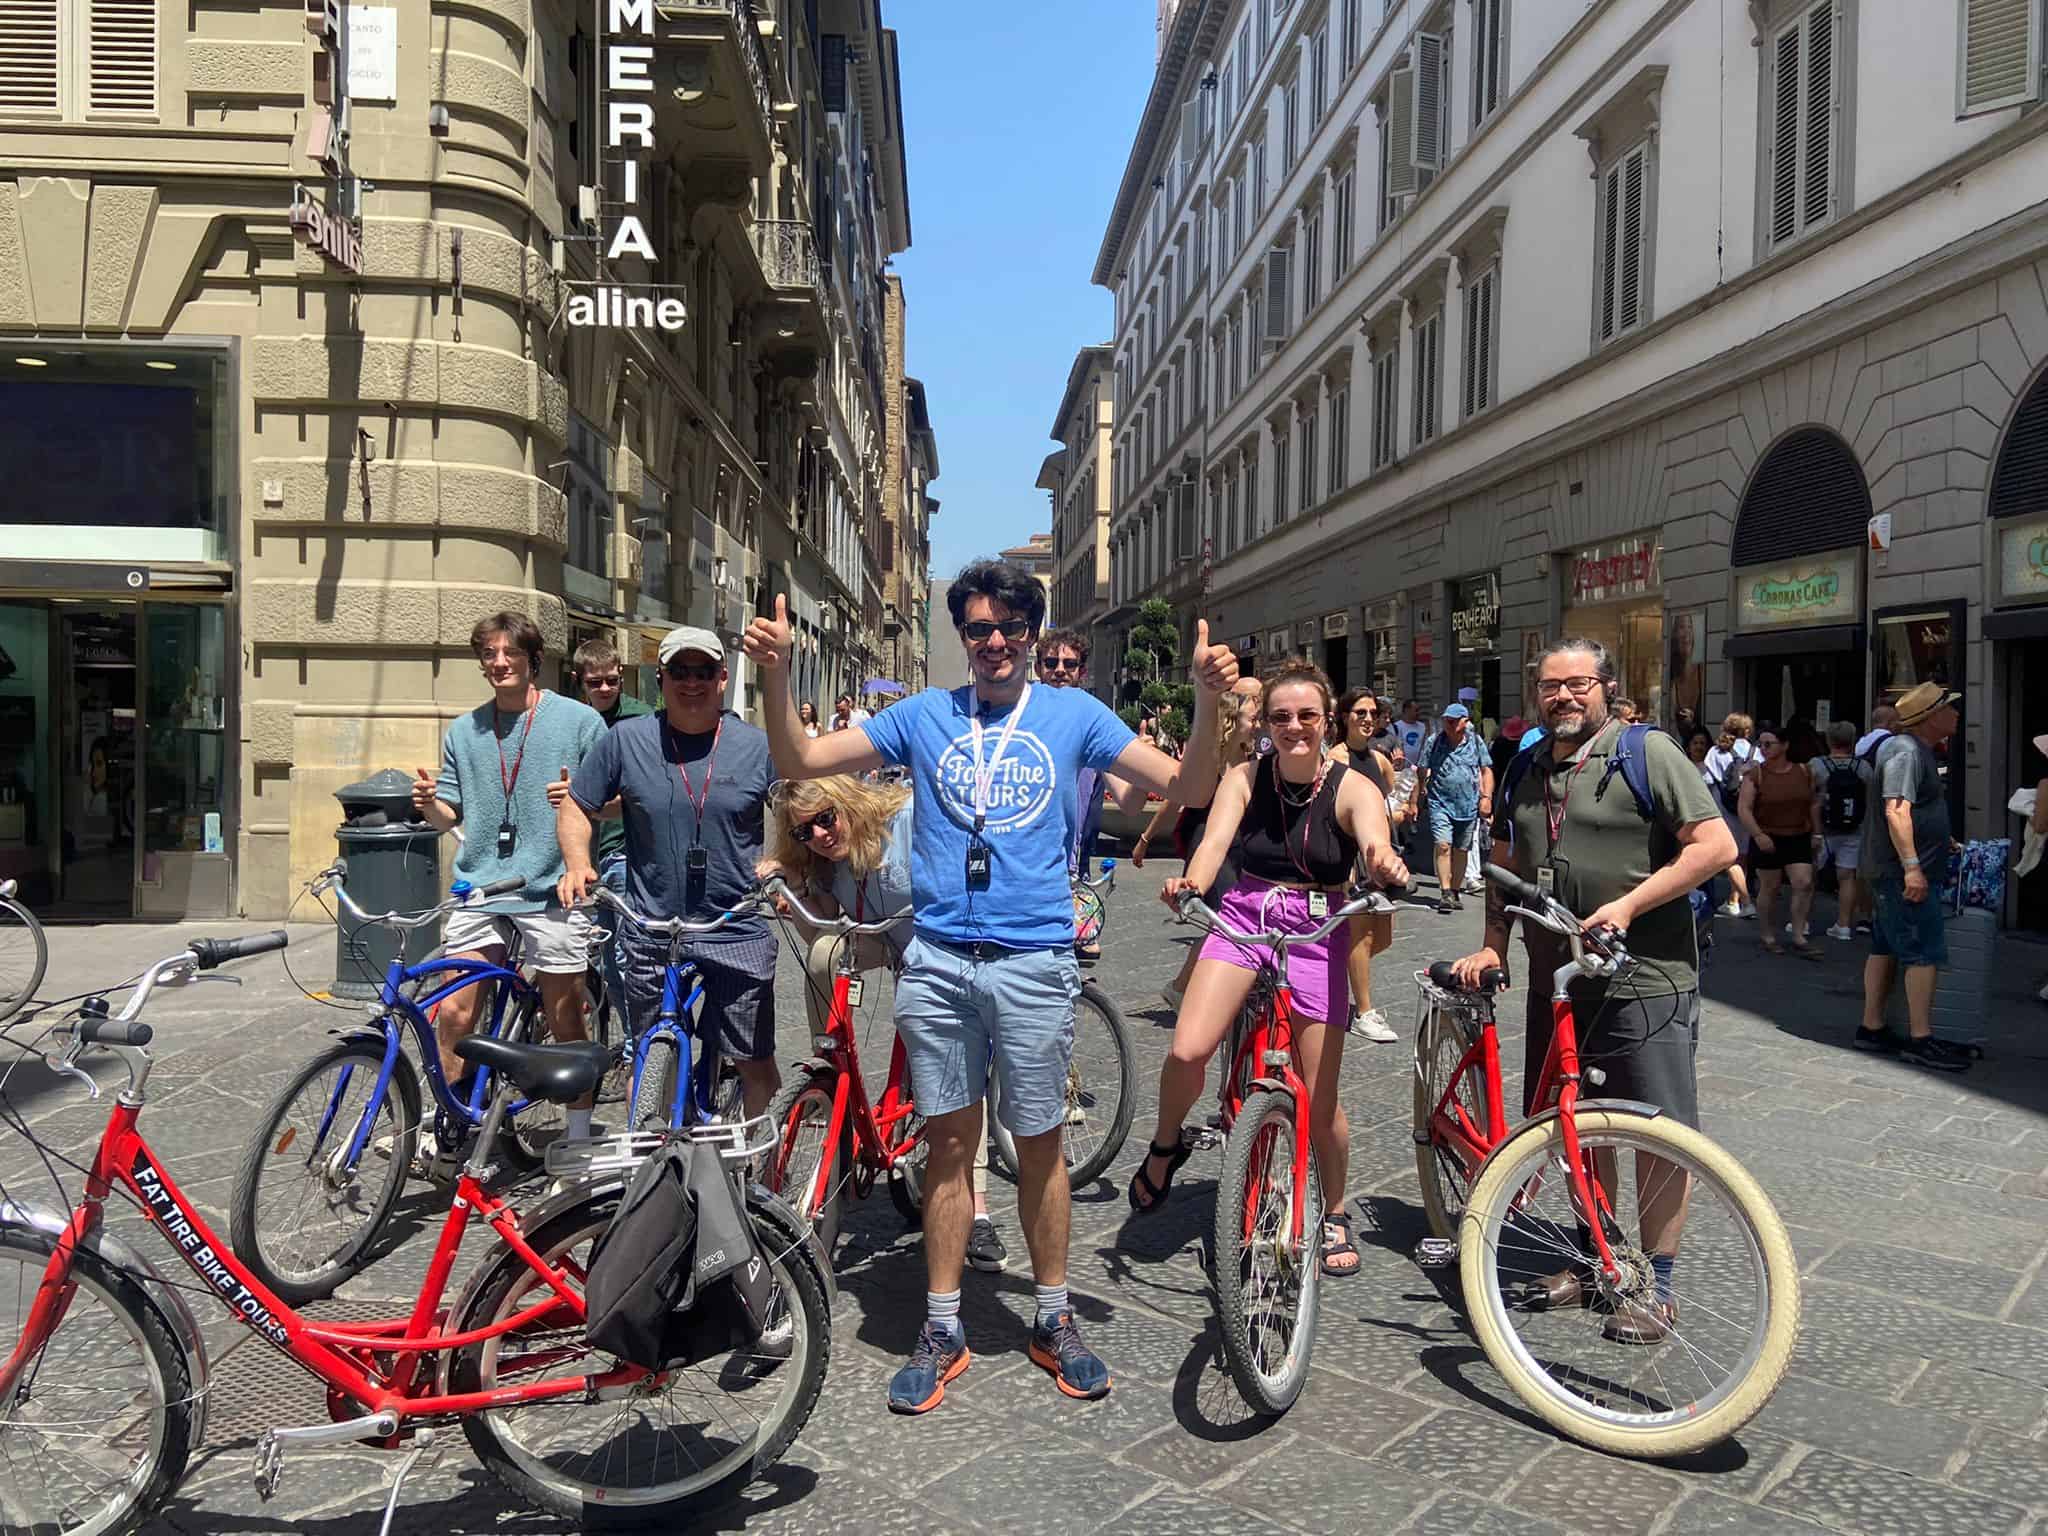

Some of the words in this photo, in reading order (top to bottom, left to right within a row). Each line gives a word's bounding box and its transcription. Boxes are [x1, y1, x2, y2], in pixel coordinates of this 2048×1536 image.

[567, 287, 687, 330] aline
[1452, 606, 1498, 632] BENHEART
[134, 1166, 170, 1205] FAT
[162, 1204, 201, 1250] TIRE
[192, 1246, 236, 1292] BIKE
[231, 1284, 289, 1343] TOURS
